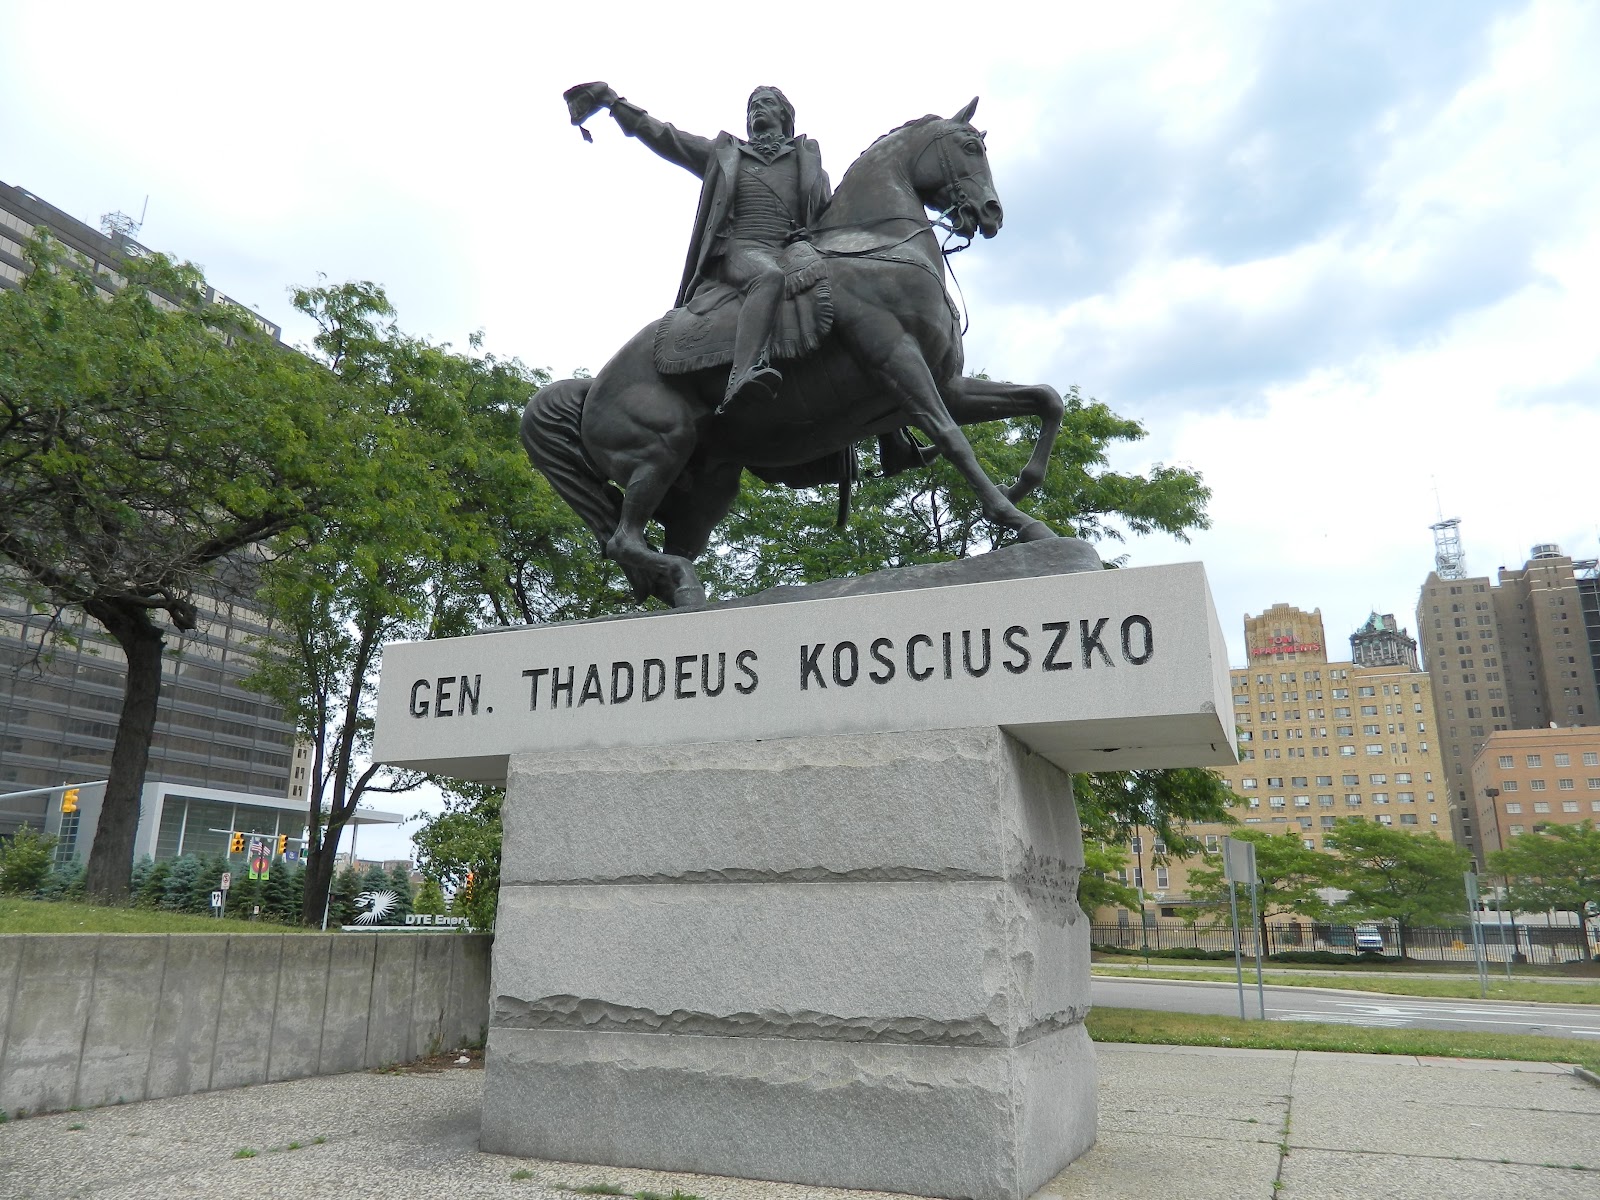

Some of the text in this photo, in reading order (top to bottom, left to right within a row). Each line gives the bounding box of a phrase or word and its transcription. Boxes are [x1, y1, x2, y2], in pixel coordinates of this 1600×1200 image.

[1269, 635, 1301, 645] TOWN
[1252, 644, 1319, 655] APARTMENTS
[409, 614, 1154, 719] GEN. THADDEUS KOSCIUSZKO
[405, 914, 470, 927] DTE Energ
